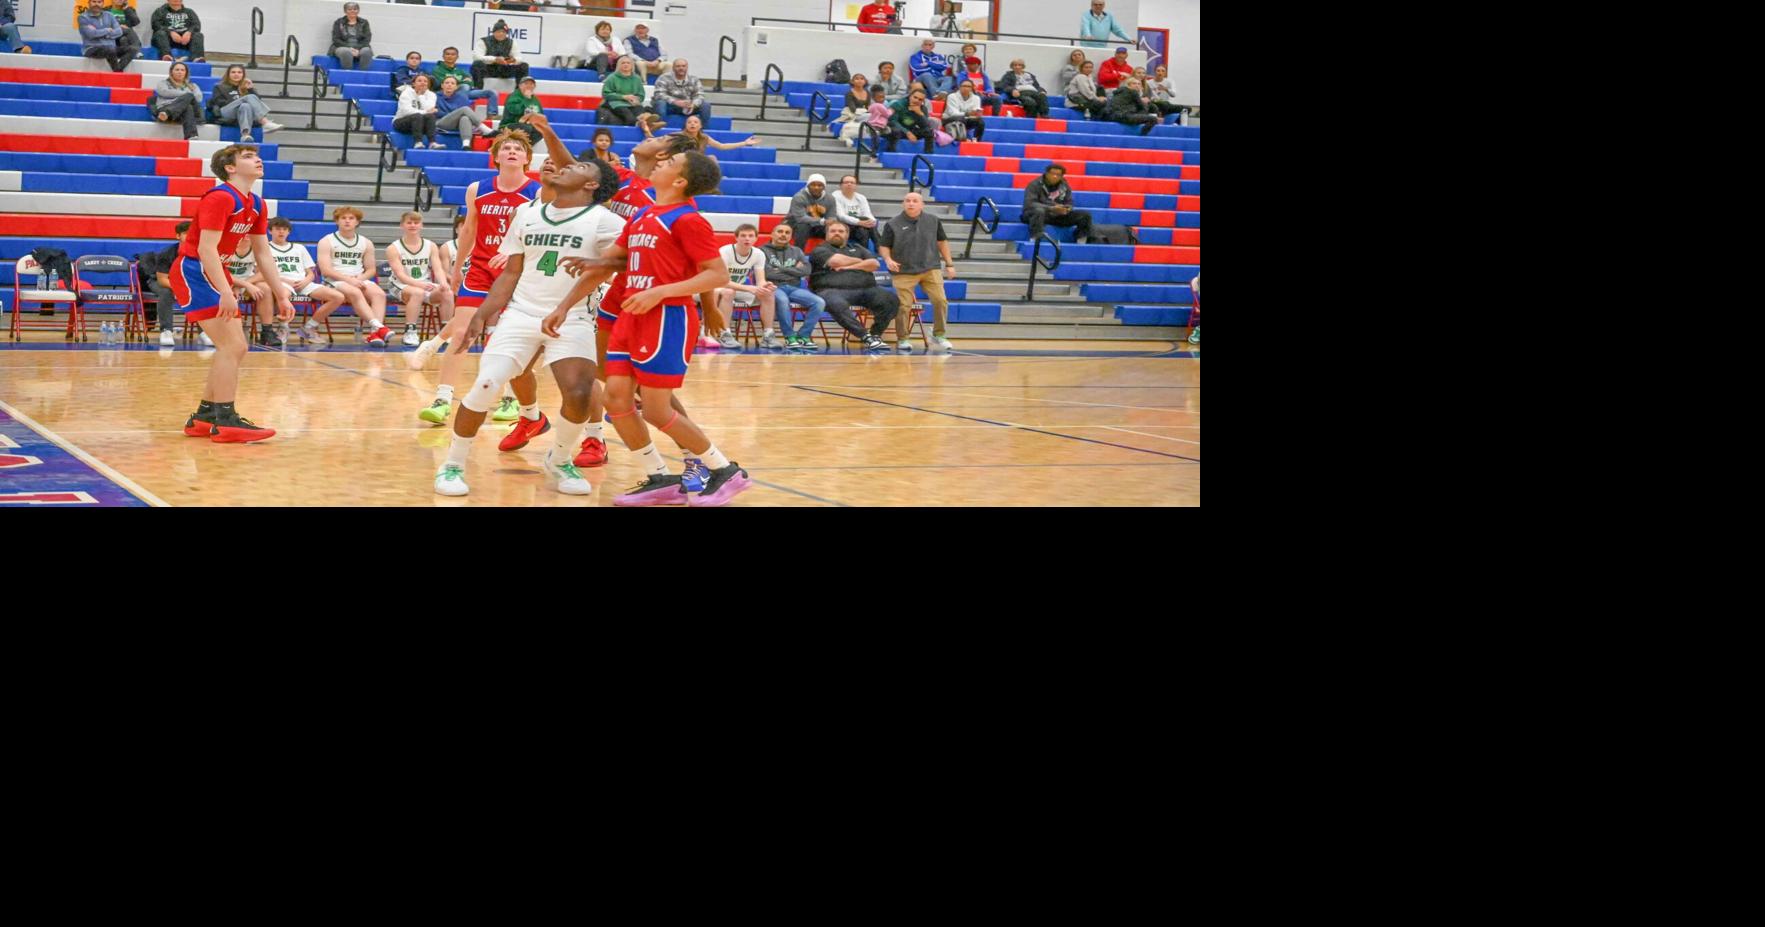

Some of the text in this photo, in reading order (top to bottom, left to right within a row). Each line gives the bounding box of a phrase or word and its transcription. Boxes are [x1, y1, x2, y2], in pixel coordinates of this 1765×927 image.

[488, 27, 527, 40] HME
[481, 204, 514, 216] HERITA
[498, 218, 506, 233] 3
[524, 233, 583, 249] CHIEFS
[334, 251, 362, 259] CHIEFS
[401, 258, 428, 266] CHIEFS
[630, 251, 640, 272] 10
[536, 250, 559, 277] 4
